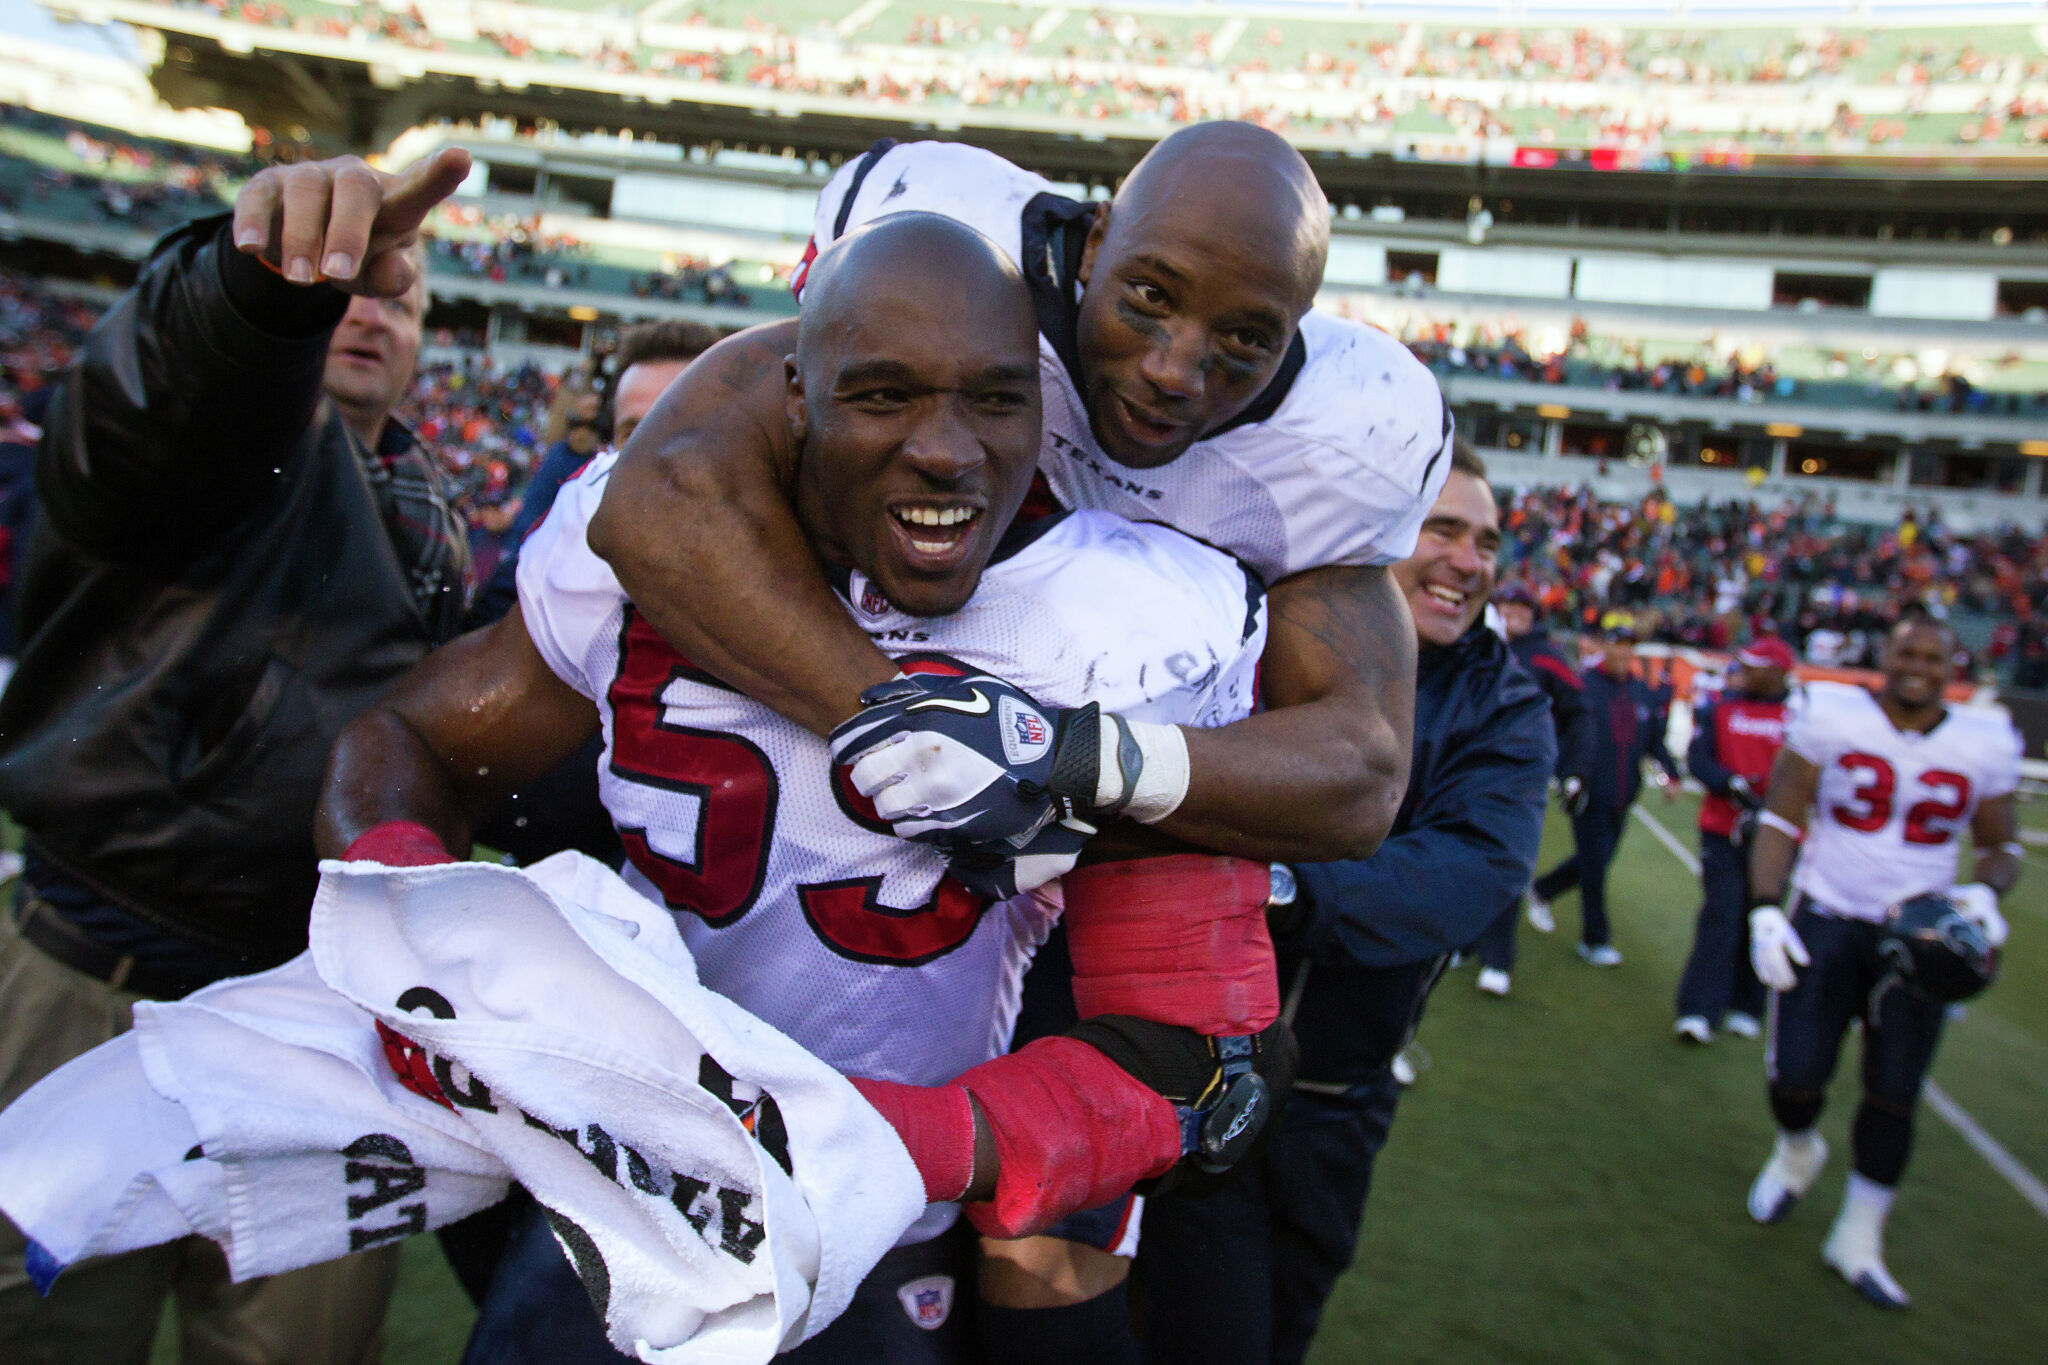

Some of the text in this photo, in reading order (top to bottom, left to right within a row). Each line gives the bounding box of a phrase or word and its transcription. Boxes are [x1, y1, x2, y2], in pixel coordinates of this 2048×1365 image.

[1050, 432, 1164, 500] TEXANS
[1005, 700, 1020, 758] EQUIPMENT
[1026, 716, 1044, 742] NFL
[1831, 750, 1971, 846] 32
